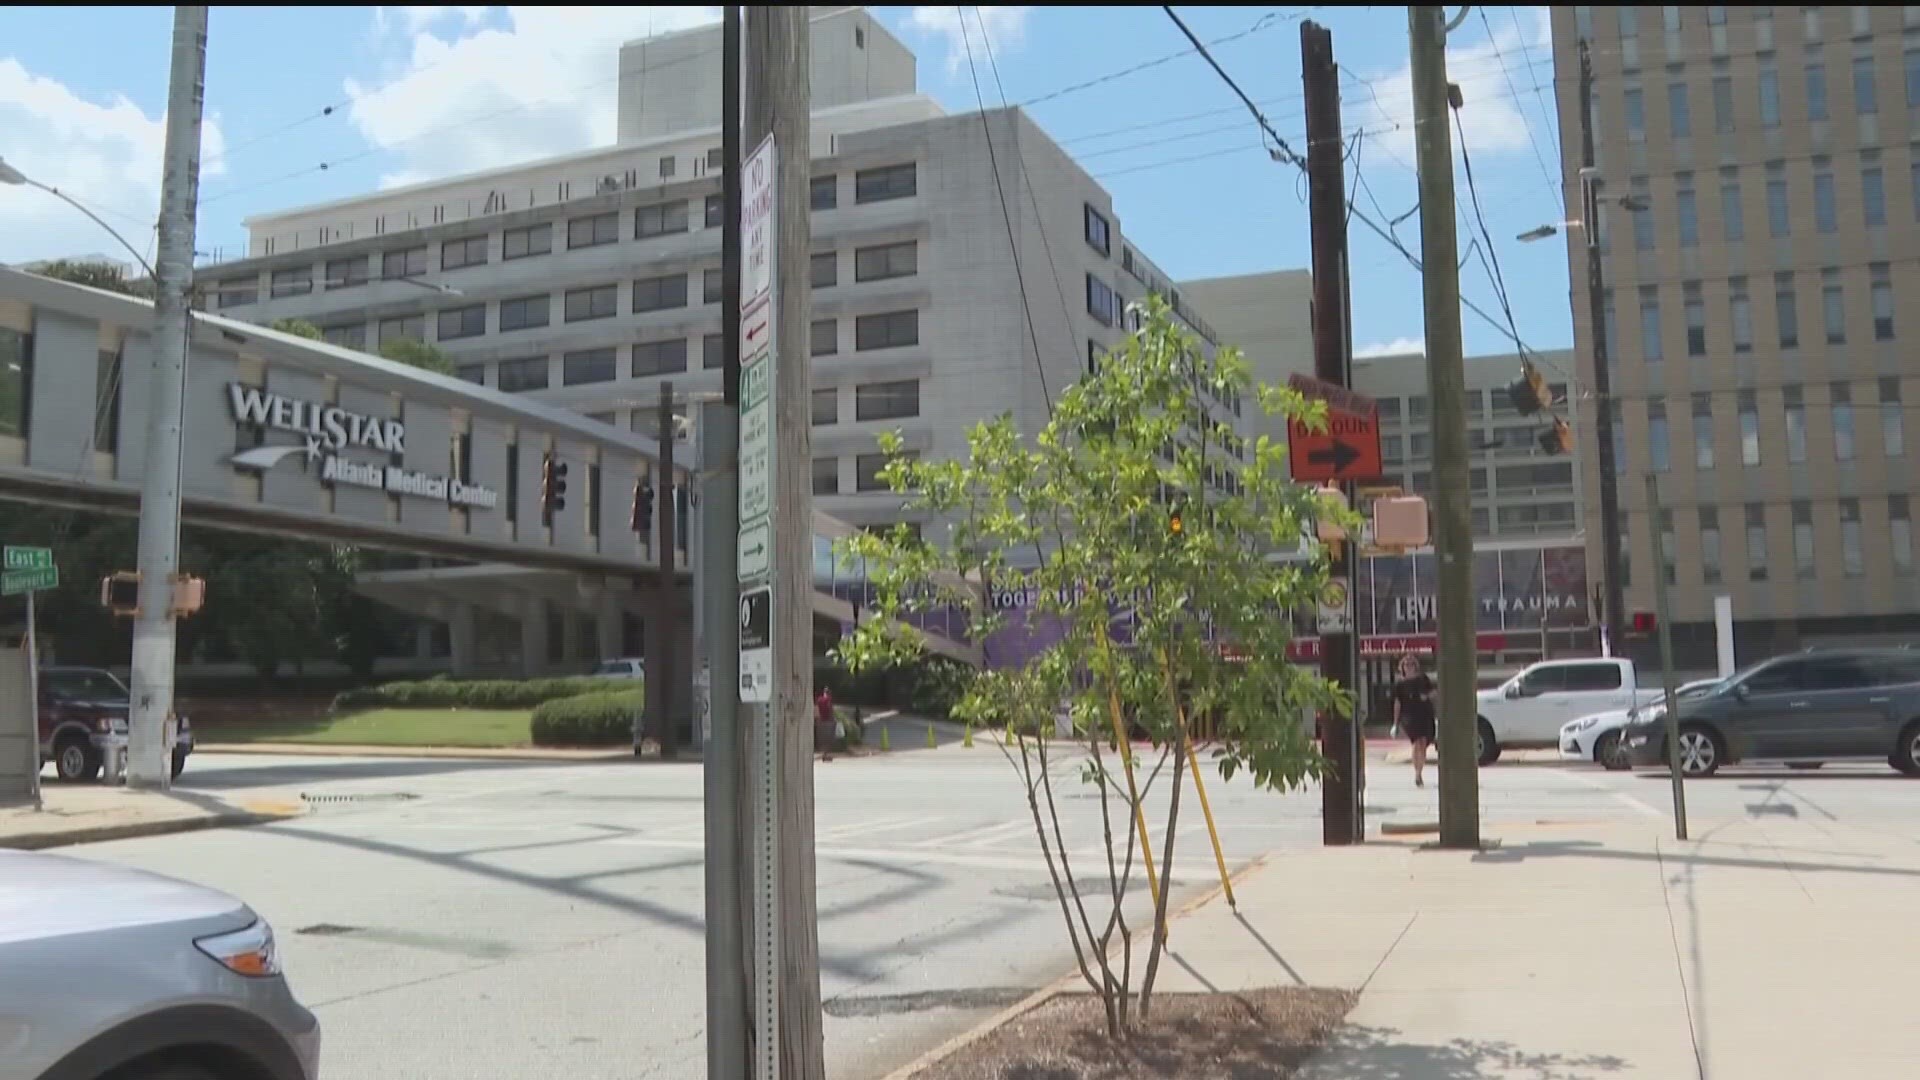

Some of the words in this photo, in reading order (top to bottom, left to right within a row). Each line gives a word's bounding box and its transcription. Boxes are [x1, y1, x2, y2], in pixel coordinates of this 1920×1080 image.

[752, 158, 763, 191] NO
[751, 227, 763, 245] ANY
[749, 246, 763, 270] TIME
[1296, 417, 1369, 435] DOUR
[323, 454, 382, 488] Atlanta
[386, 466, 449, 500] Medical
[451, 478, 498, 508] Center
[1482, 594, 1577, 612] TRAUMA
